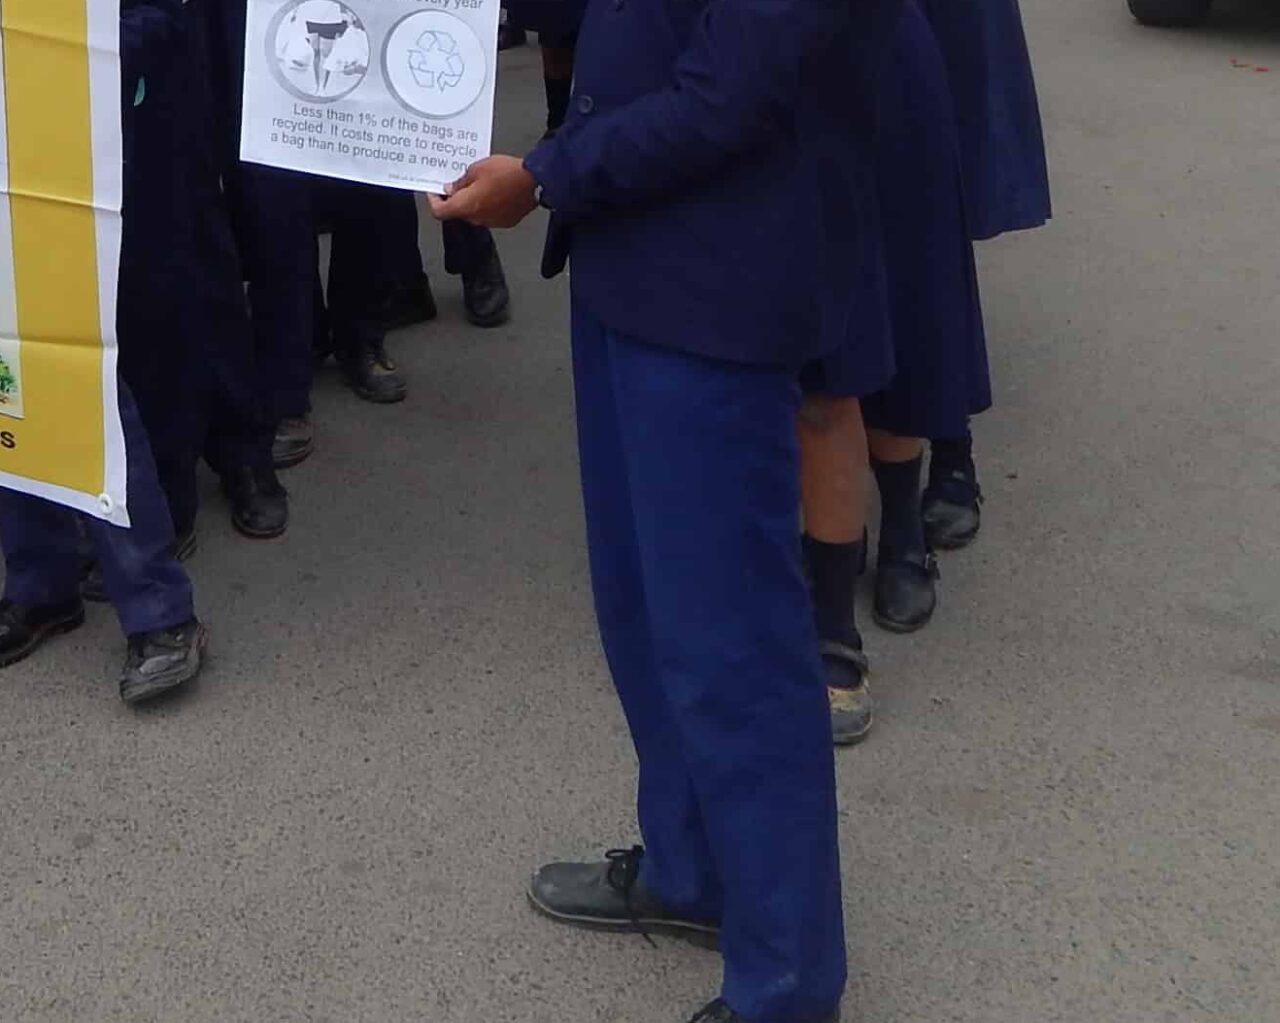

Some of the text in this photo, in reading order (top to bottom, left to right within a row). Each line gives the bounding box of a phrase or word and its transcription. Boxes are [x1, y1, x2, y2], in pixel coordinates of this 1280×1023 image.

[272, 116, 477, 159] recycled. It costs more to recycle
[293, 103, 478, 142] Less than 1% of the bags are
[270, 132, 279, 142] a
[282, 132, 305, 149] bag
[308, 137, 335, 152] than
[337, 141, 350, 154] to
[352, 146, 405, 163] produce
[408, 152, 417, 164] a
[421, 157, 448, 169] new
